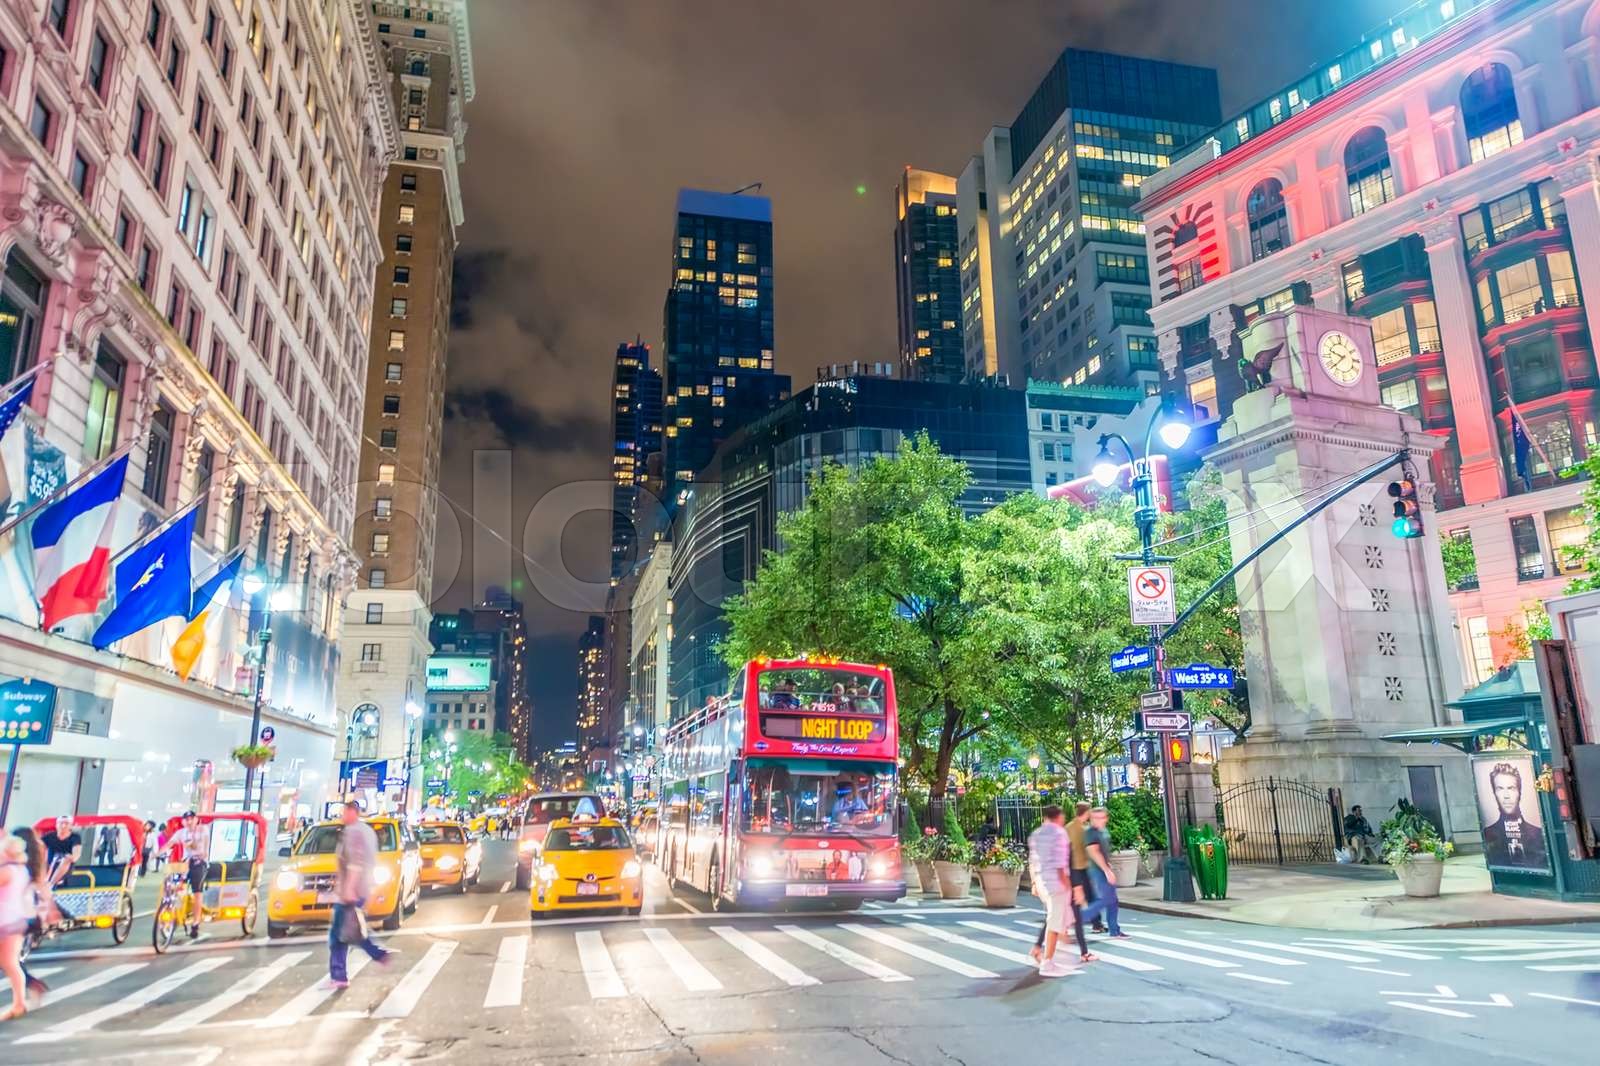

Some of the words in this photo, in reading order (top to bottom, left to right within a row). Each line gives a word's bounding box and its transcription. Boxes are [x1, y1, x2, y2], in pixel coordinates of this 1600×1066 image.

[1112, 655, 1130, 669] Herald
[1130, 653, 1149, 666] Square
[1175, 672, 1199, 685] West
[1200, 672, 1217, 684] 35th
[1218, 672, 1229, 684] St
[3, 691, 47, 703] Subway
[801, 718, 838, 738] NIGHT
[840, 719, 873, 740] LOOP
